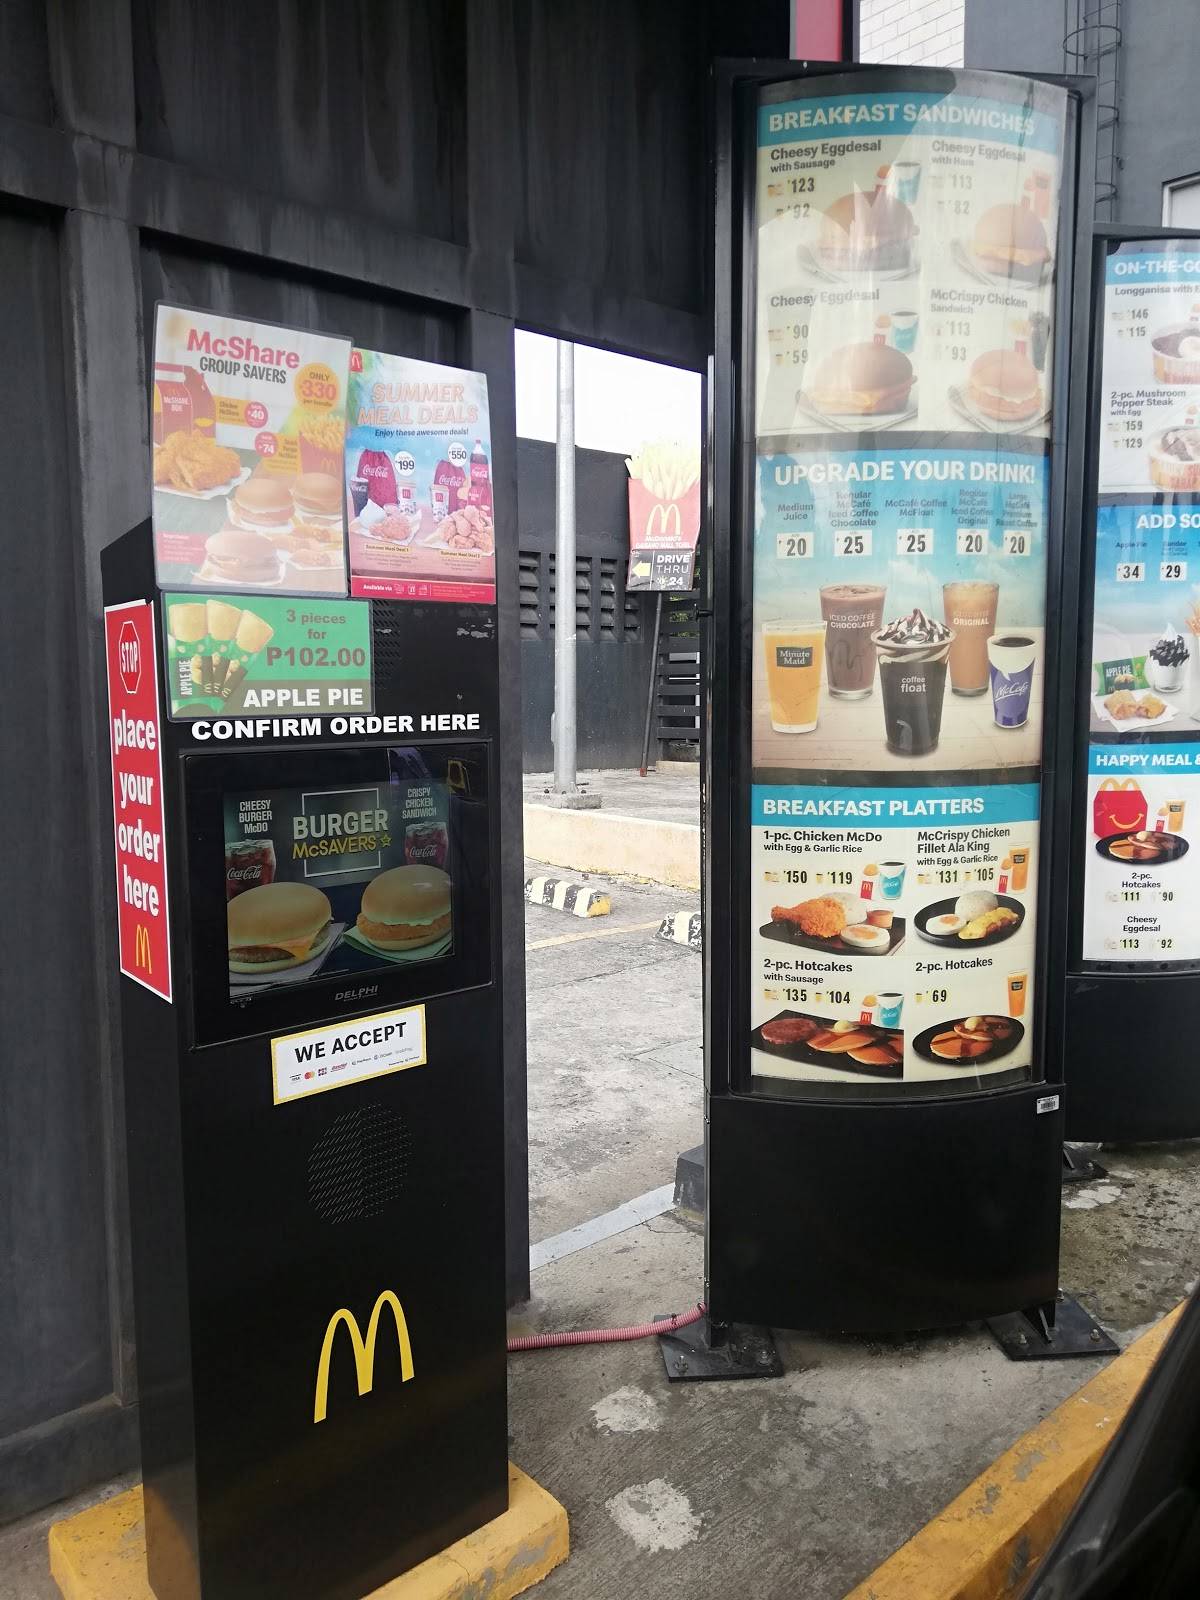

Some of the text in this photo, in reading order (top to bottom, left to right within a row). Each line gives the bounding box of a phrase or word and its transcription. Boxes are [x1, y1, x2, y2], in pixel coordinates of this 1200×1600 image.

[769, 103, 1036, 136] BREAKFAST SANDWICHES
[771, 140, 881, 162] Cheesy Eggdesal
[932, 140, 1026, 162] Cheesy Eggdesal
[770, 158, 835, 173] with Sausage
[770, 294, 817, 308] Cheesy
[930, 288, 1028, 308] McCrispy Chicken
[186, 328, 300, 368] McShare
[200, 356, 287, 384] GROUP SAVERS
[302, 380, 336, 400] 330
[372, 382, 464, 404] SUMMER
[1136, 390, 1186, 398] Mushroom
[1111, 398, 1174, 408] Pepper Steak
[357, 404, 478, 425] MEAL DEALS
[375, 428, 394, 437] Enjoy
[396, 428, 415, 436] these
[775, 460, 1035, 486] UPGRADE YOUR DRINK!
[778, 503, 814, 512] Medium
[784, 512, 808, 520] Juice
[1136, 514, 1176, 528] ADD
[831, 519, 877, 527] Chocolate
[657, 554, 690, 563] DRIVE
[656, 565, 689, 574] THRU
[286, 609, 346, 625] 3 pieces
[954, 617, 989, 626] ORIGINAL
[830, 620, 875, 629] CHOCOLATE
[308, 629, 327, 639] for
[121, 641, 138, 673] STOP
[266, 647, 366, 667] P102.00
[779, 650, 810, 659] Minute
[783, 657, 806, 665] Maid
[901, 676, 925, 684] coffee
[900, 683, 926, 692] float
[243, 688, 364, 708] APPLE PIE
[114, 709, 156, 755] place
[192, 714, 480, 740] CONFIRM ORDER HERE
[1096, 754, 1150, 766] HAPPY
[1152, 754, 1192, 766] MEAL
[120, 771, 154, 809] your
[407, 787, 431, 798] CRISPY
[240, 799, 271, 812] CHEESY
[405, 798, 433, 808] CHICKEN
[763, 798, 984, 816] BREAKFAST PLATTERS
[239, 810, 272, 823] BURGER
[402, 807, 437, 819] SANDWICH
[244, 822, 268, 834] McDO
[293, 809, 389, 840] BURGER
[118, 819, 160, 862] order
[763, 831, 882, 842] 1-pc. Chicken McDo
[917, 828, 1010, 842] McCrispy Chicken
[292, 835, 377, 860] McSAVERS
[785, 844, 802, 853] Egg
[813, 844, 840, 852] Garlic
[917, 841, 990, 854] Fillet Ala King
[937, 858, 952, 866] Egg
[961, 855, 982, 864] Garlic
[1132, 872, 1152, 881] 2-pc.
[123, 864, 159, 917] here
[1122, 881, 1161, 889] Hotcakes
[1127, 916, 1158, 925] Cheesy
[1123, 925, 1160, 933] Eggdesal
[764, 958, 853, 972] 2-pc. Hotcakes
[916, 957, 993, 974] 2-pc. Hotcakes
[764, 973, 824, 985] with Sausage
[334, 985, 378, 1000] DELPHI
[295, 1042, 326, 1063] WE
[332, 1022, 407, 1054] ACCEPT
